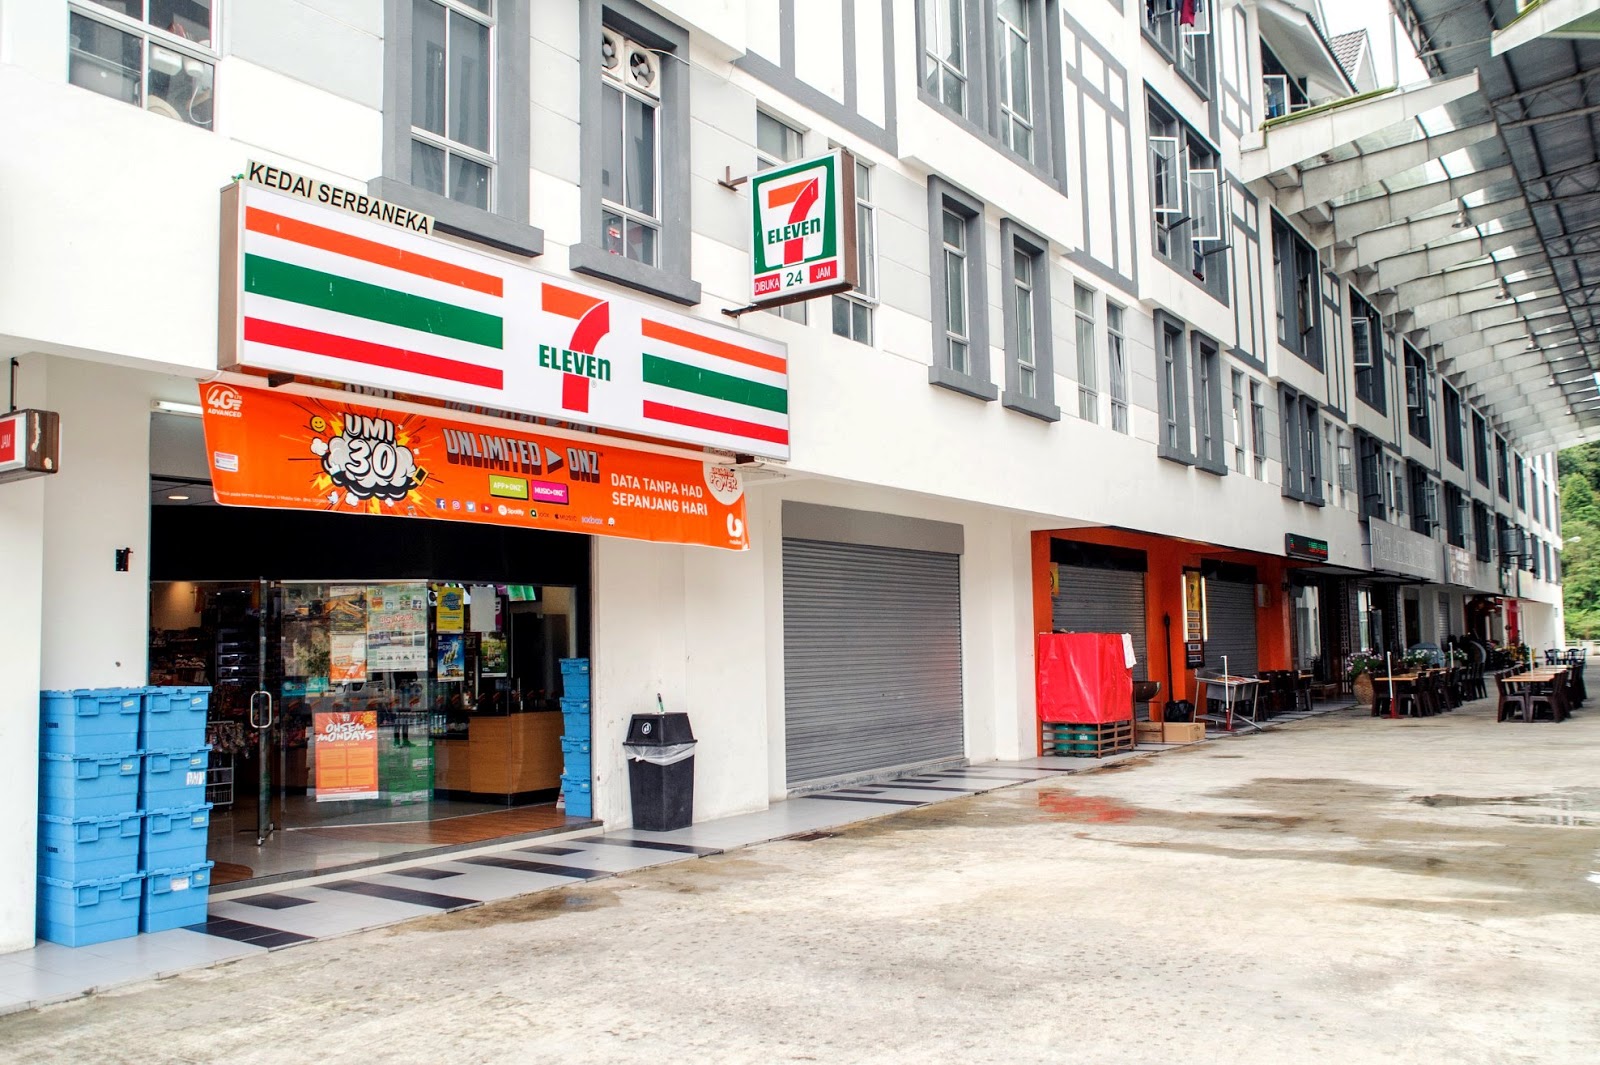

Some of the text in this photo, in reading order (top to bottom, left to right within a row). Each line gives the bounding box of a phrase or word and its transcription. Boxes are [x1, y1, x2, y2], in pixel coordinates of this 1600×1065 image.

[248, 161, 429, 235] KEDAI SERBANEKA
[768, 176, 819, 265] 7
[754, 266, 831, 293] DIBUKA 24 JAM
[541, 282, 610, 413] 7
[207, 389, 242, 410] 4G
[207, 408, 242, 418] ADVANCED
[343, 412, 396, 443] UMI
[346, 437, 398, 478] 30
[443, 428, 601, 482] UNLIMITED ONZ
[611, 473, 703, 498] DATA TANPA HAD
[709, 472, 738, 492] POWER
[507, 507, 525, 517] Spotify
[612, 491, 708, 516] SEPANJANG HARI
[317, 730, 376, 743] MONDAYS
